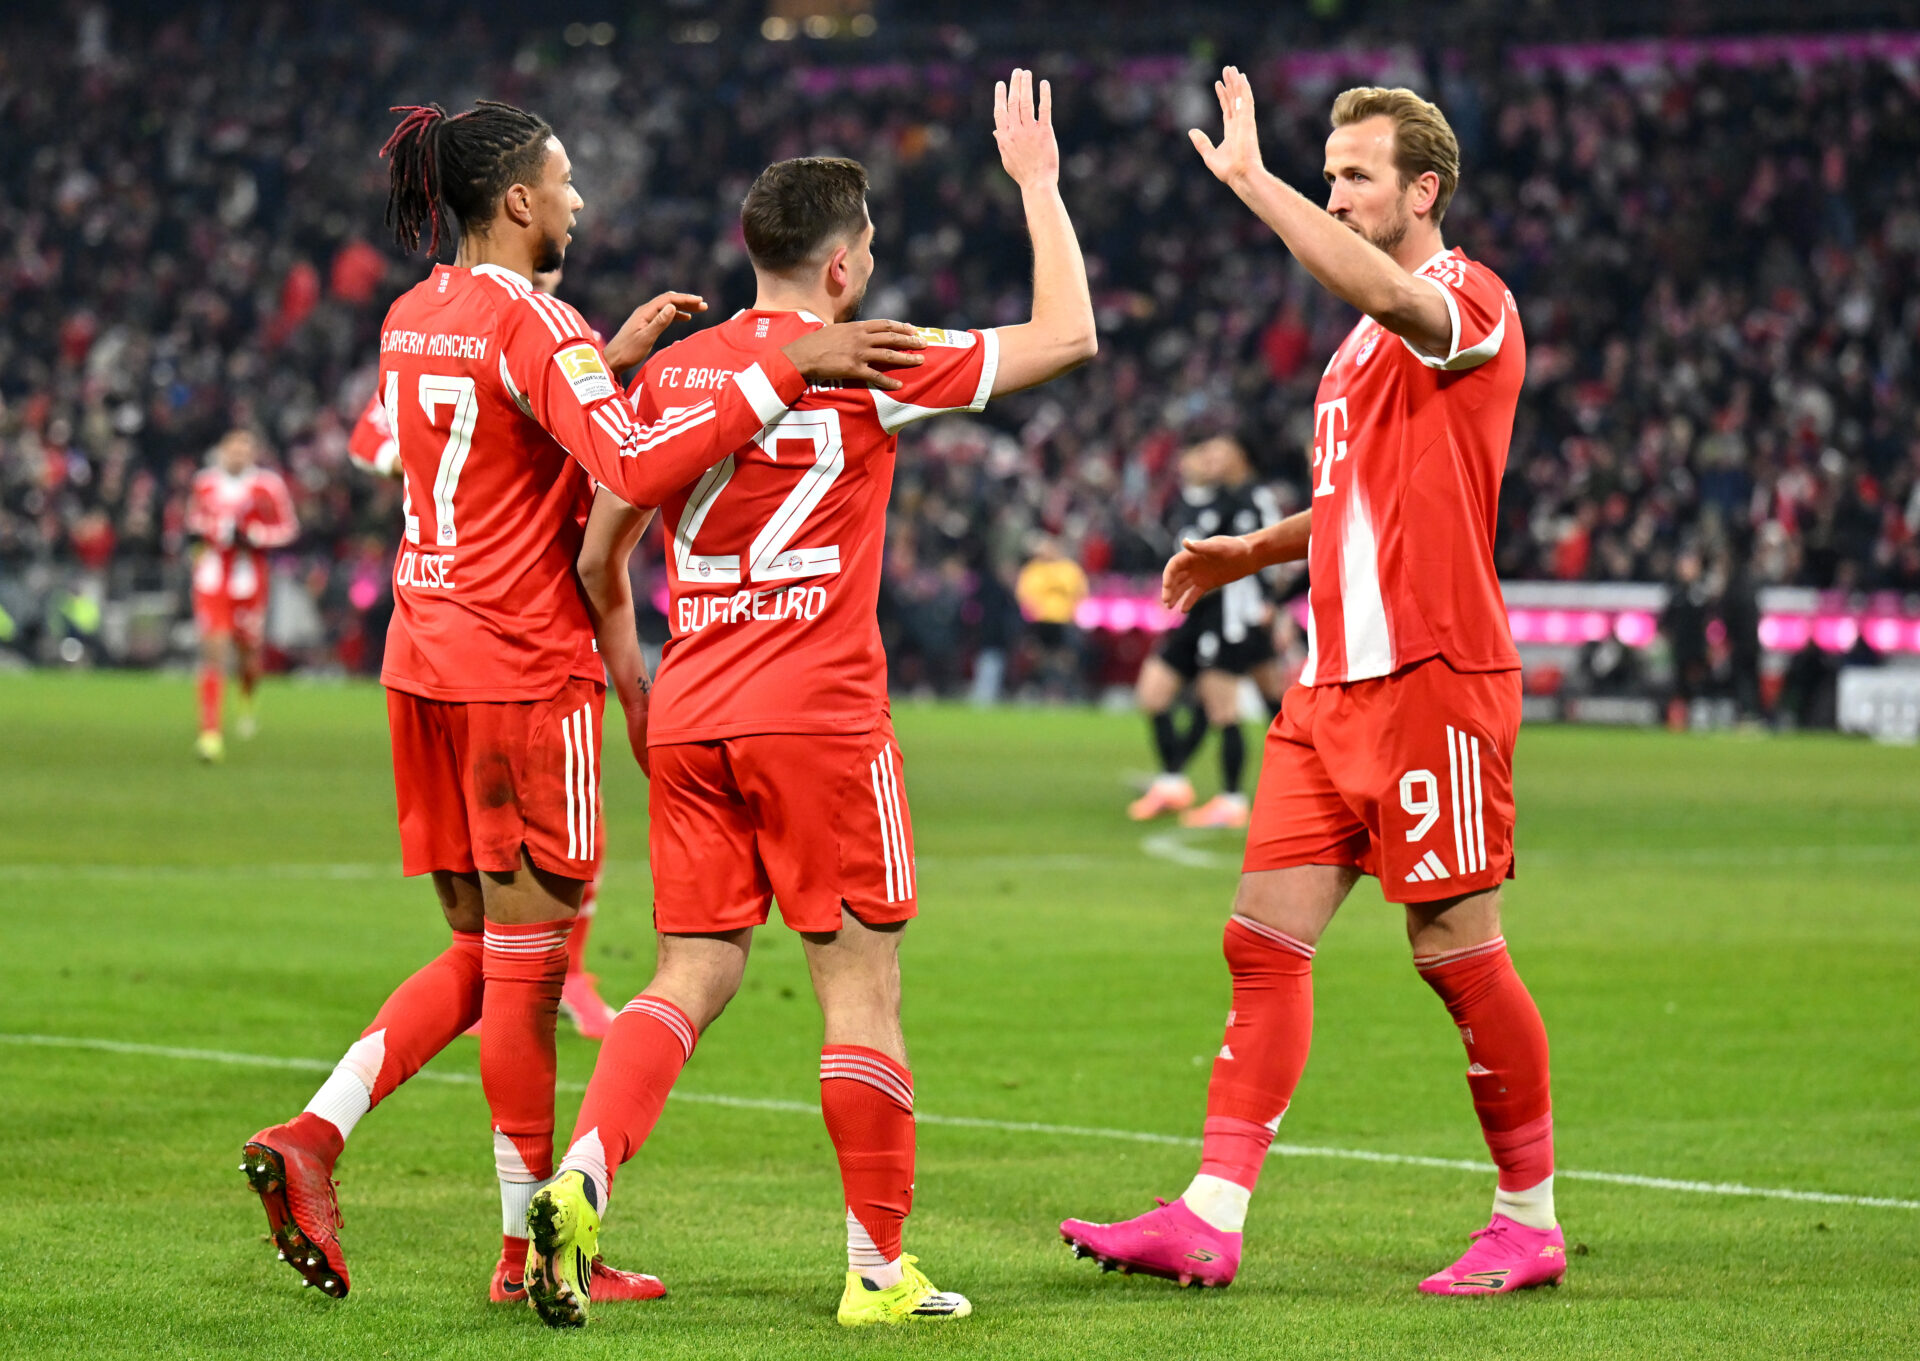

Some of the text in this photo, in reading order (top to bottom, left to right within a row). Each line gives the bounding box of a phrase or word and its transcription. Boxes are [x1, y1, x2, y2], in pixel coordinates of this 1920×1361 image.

[658, 367, 733, 390] FC BAYE
[1313, 397, 1348, 498] T
[397, 552, 456, 589] OLISE
[1399, 769, 1440, 843] 9
